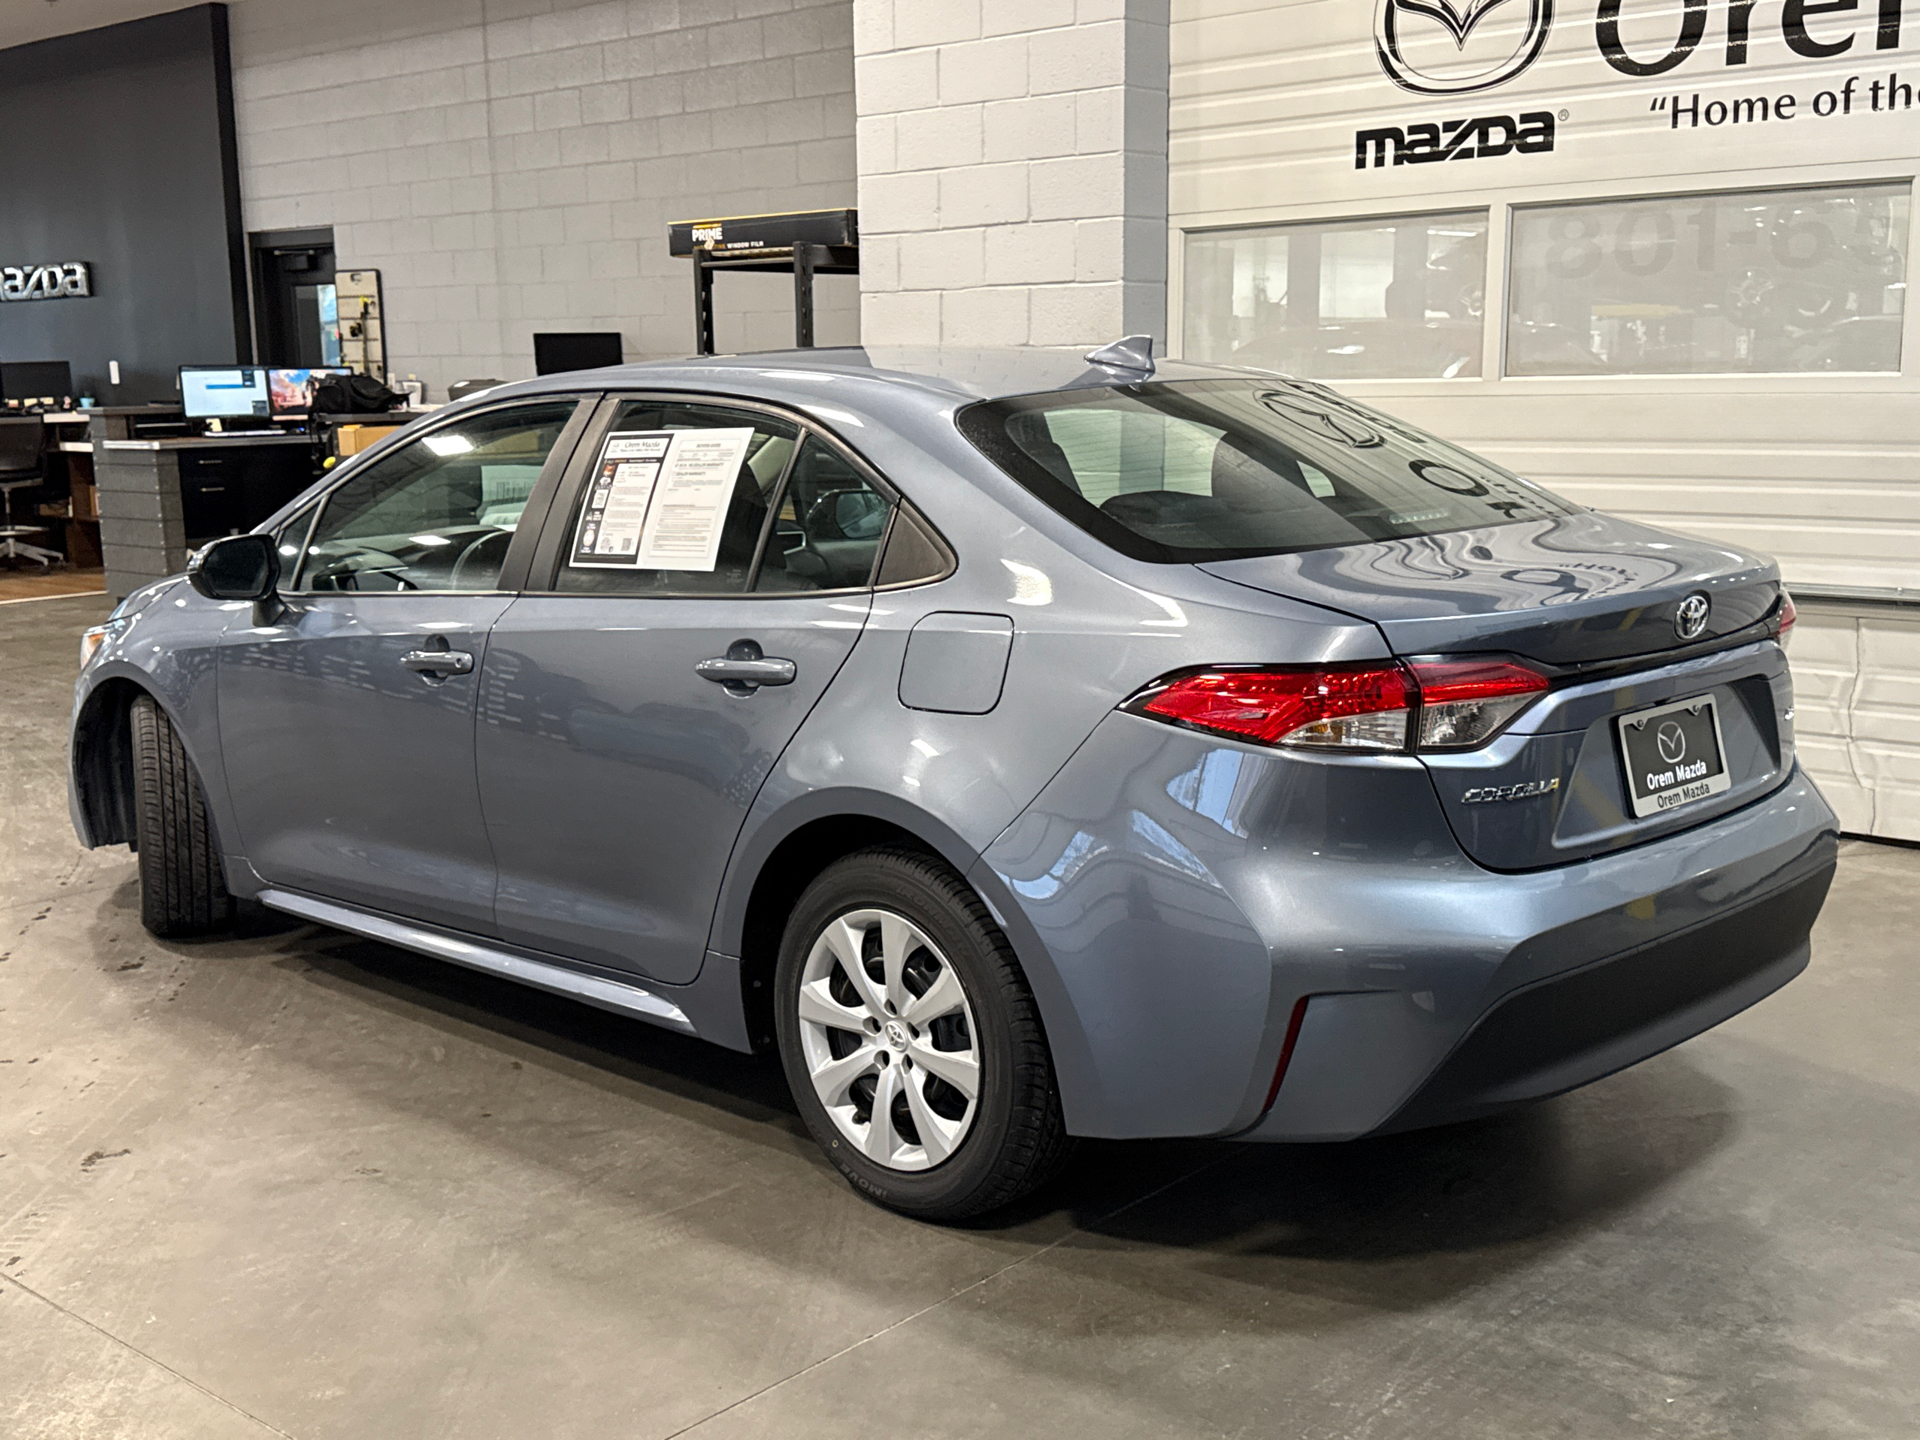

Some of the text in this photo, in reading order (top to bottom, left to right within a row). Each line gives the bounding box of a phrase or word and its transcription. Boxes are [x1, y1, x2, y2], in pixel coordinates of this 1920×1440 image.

[1595, 0, 1902, 77] Ore
[1812, 76, 1859, 117] of
[1869, 73, 1920, 112] th
[1355, 111, 1555, 170] mazda
[692, 227, 723, 242] PRIME
[0, 262, 90, 300] azda
[1461, 778, 1559, 803] COROLLA
[1646, 759, 1707, 790] Orem Mazda
[1657, 782, 1710, 809] Orem Mazda
